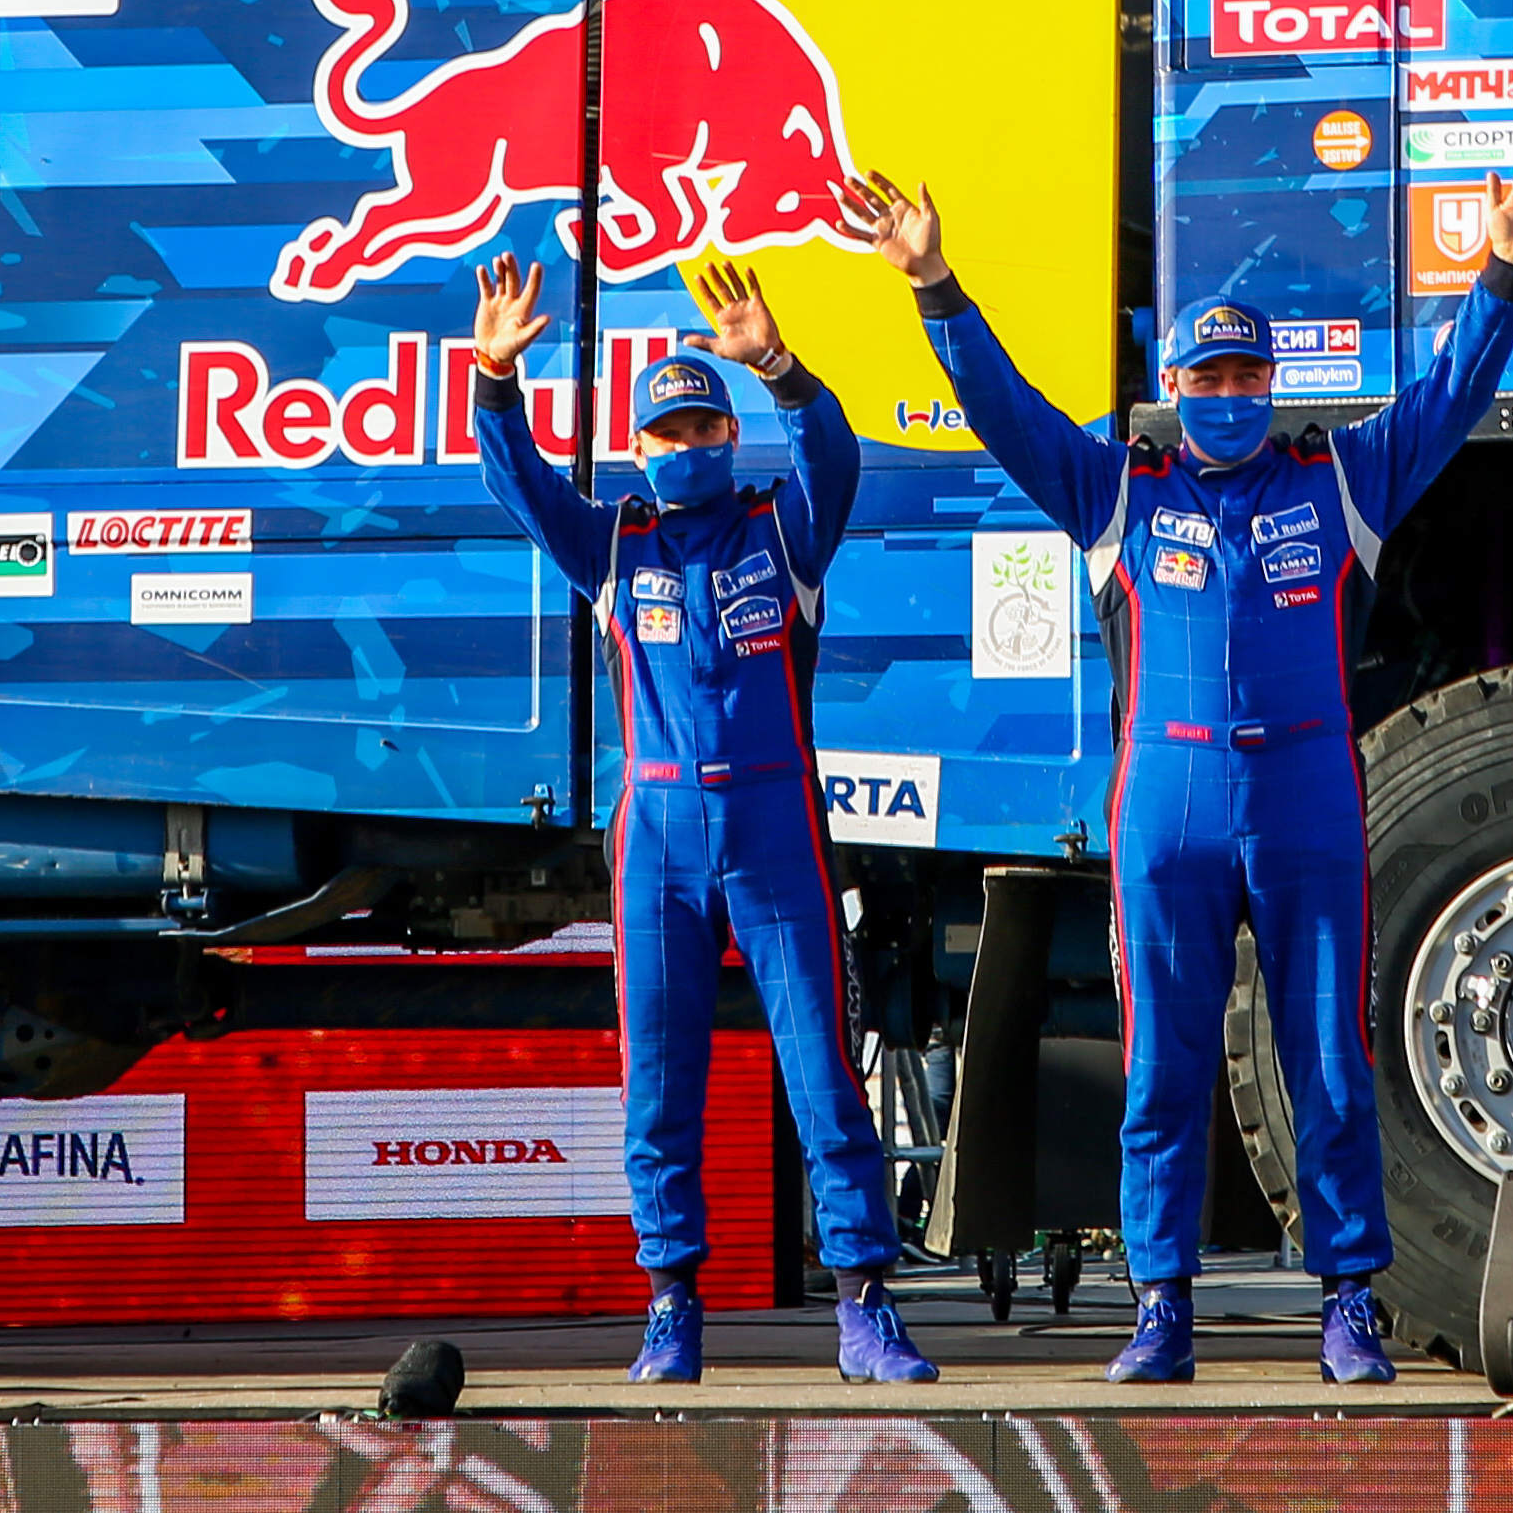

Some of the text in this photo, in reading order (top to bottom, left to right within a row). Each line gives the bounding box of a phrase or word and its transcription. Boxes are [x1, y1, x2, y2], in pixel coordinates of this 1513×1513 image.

[1222, 0, 1435, 46] TOTAL
[1321, 121, 1362, 137] BALISE
[1416, 269, 1482, 287] ЧЕМПИО
[1329, 327, 1356, 346] 24
[1284, 365, 1354, 385] @rallykm
[181, 335, 424, 465] Red
[74, 515, 247, 550] LOCTITE
[1174, 518, 1211, 543] VTB
[140, 589, 244, 602] OMNICOMM
[650, 575, 685, 598] VTB
[1288, 591, 1318, 604] TOTAL
[749, 639, 781, 652] TOTAL
[372, 1139, 568, 1167] HONDA
